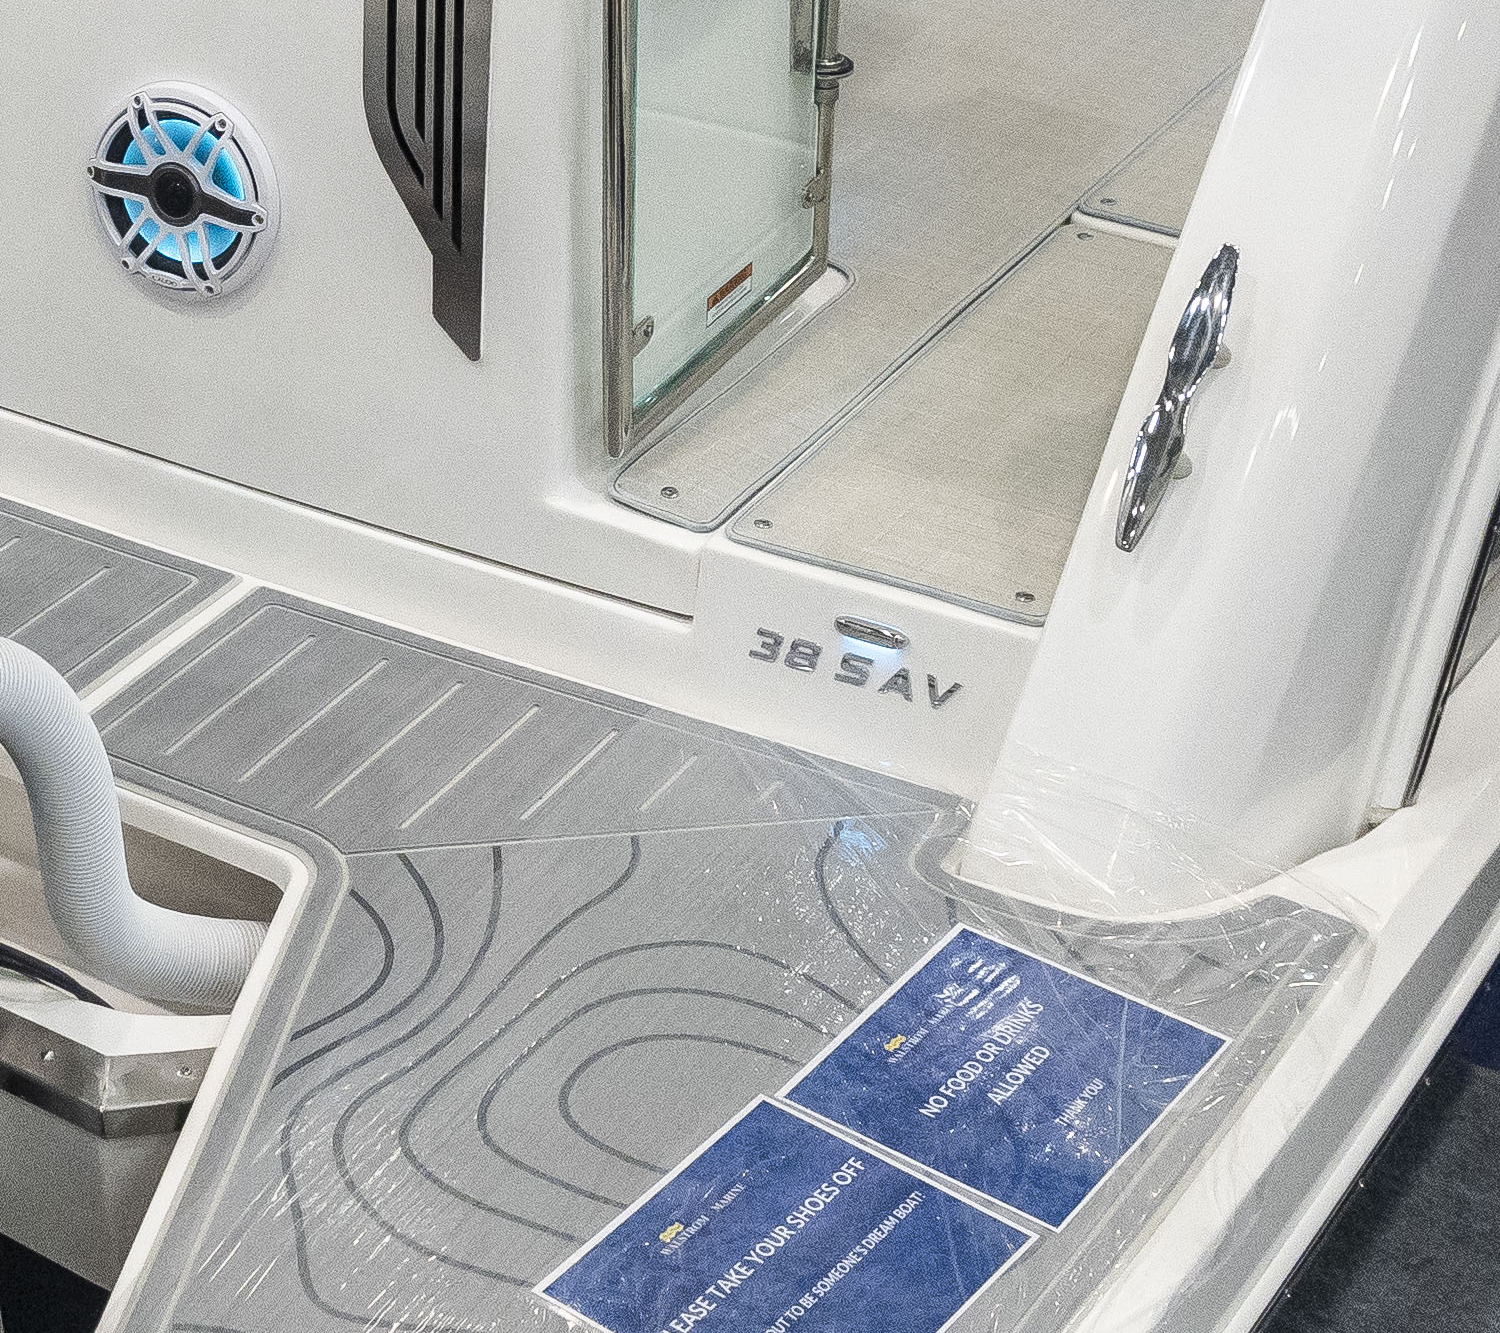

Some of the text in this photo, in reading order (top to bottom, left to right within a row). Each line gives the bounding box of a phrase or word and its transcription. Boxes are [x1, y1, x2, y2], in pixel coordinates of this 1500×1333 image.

[748, 627, 824, 673] 38
[918, 995, 1045, 1119] NO FOOD OR DRINKS
[986, 1045, 1051, 1107] ALLOWED
[1054, 1095, 1088, 1126] THANK
[660, 1214, 710, 1256] WALSTROM
[662, 1155, 866, 1333] EASE TAKE YOUR SHOES OFF
[784, 1304, 806, 1323] TO
[798, 1292, 820, 1312] BE
[811, 1244, 869, 1298] SOMEONE'S
[861, 1214, 901, 1255] DREAM
[891, 1190, 928, 1222] BOAT!
